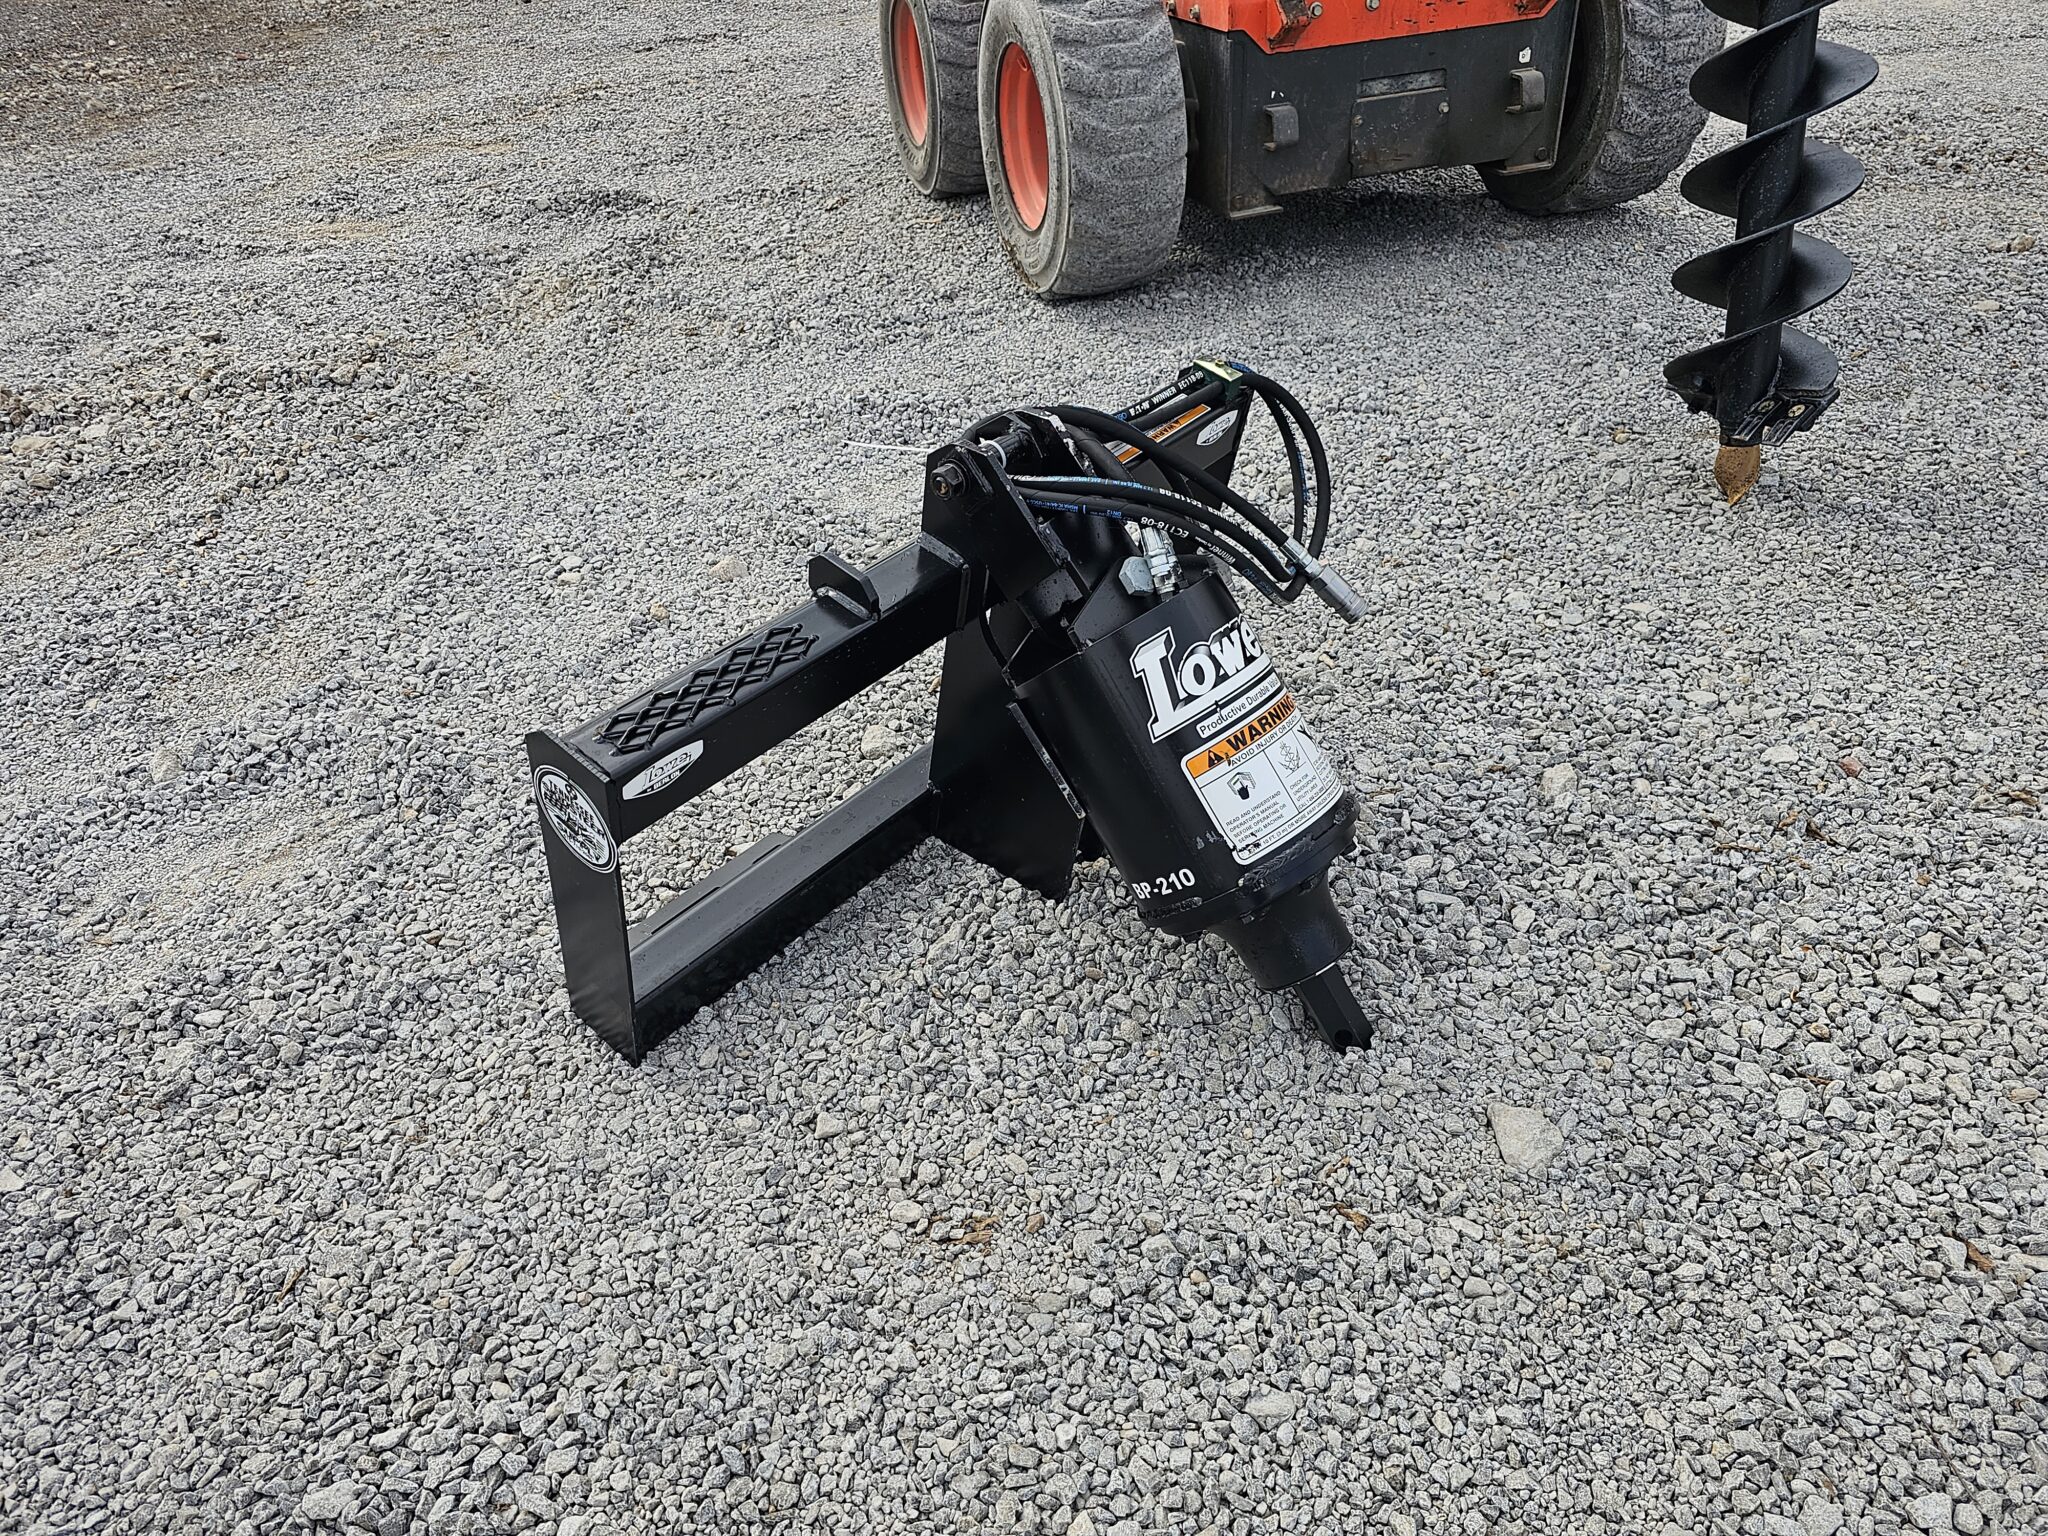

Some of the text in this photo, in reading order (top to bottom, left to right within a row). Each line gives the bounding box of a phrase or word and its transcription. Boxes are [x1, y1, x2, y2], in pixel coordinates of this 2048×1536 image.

[1151, 386, 1177, 405] WINNER
[1140, 516, 1189, 539] EC118-08
[1210, 545, 1236, 564] Winner
[1130, 614, 1266, 743] Lowe
[1199, 703, 1247, 735] Productive
[1246, 686, 1270, 707] Durable
[1227, 694, 1296, 750] WARNING
[1230, 747, 1255, 767] AVOID
[1255, 732, 1279, 751] INJURY
[1278, 724, 1288, 734] OR
[1225, 790, 1281, 827] READ AND UNDERSTAND
[1252, 807, 1280, 827] OPERATING
[1259, 801, 1280, 815] MANUAL
[1131, 868, 1195, 899] BP-210
